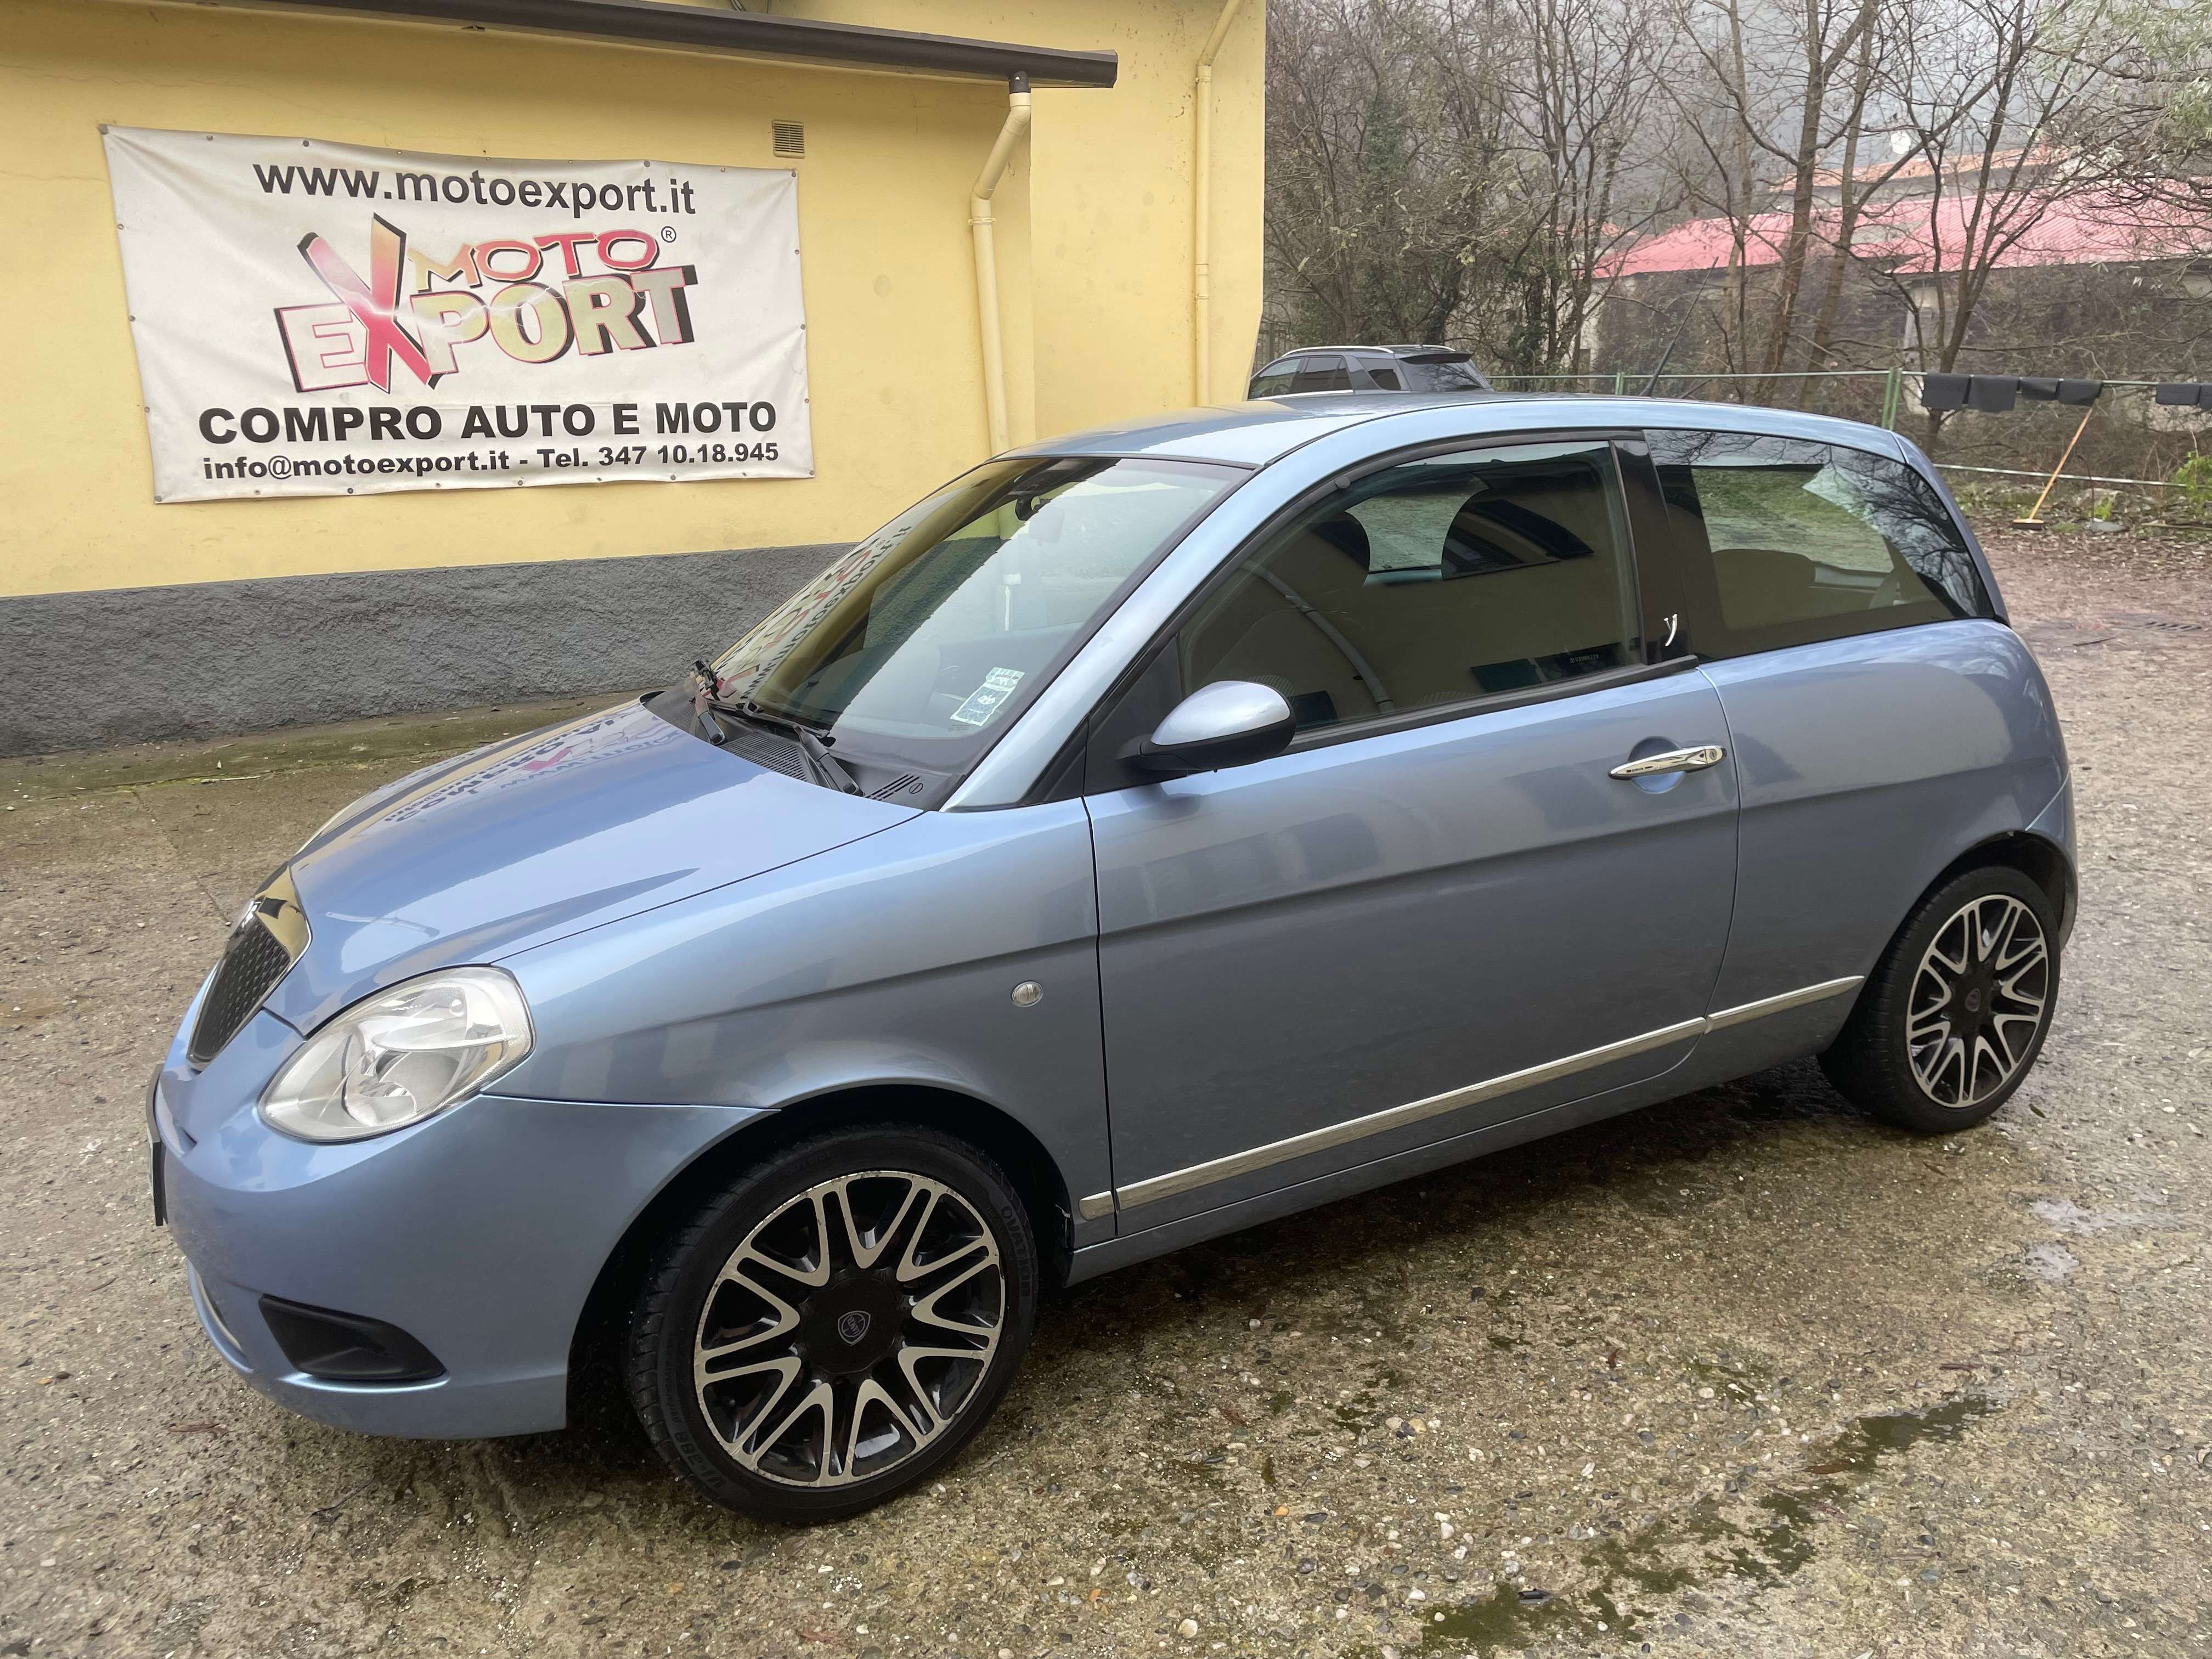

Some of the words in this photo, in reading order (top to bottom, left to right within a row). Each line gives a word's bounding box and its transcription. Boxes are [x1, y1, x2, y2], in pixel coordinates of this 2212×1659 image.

[252, 163, 696, 218] www.motoexport.it
[409, 229, 659, 294] MOTO
[274, 212, 698, 394] EXPORT
[199, 405, 442, 444] COMPRO
[461, 403, 595, 439] AUTO
[613, 403, 639, 435] E
[656, 401, 776, 434] MOTO
[203, 448, 510, 479] info@motoexport.it
[537, 447, 589, 468] Tel.
[599, 445, 647, 465] 347
[657, 442, 778, 464] 10.18.945
